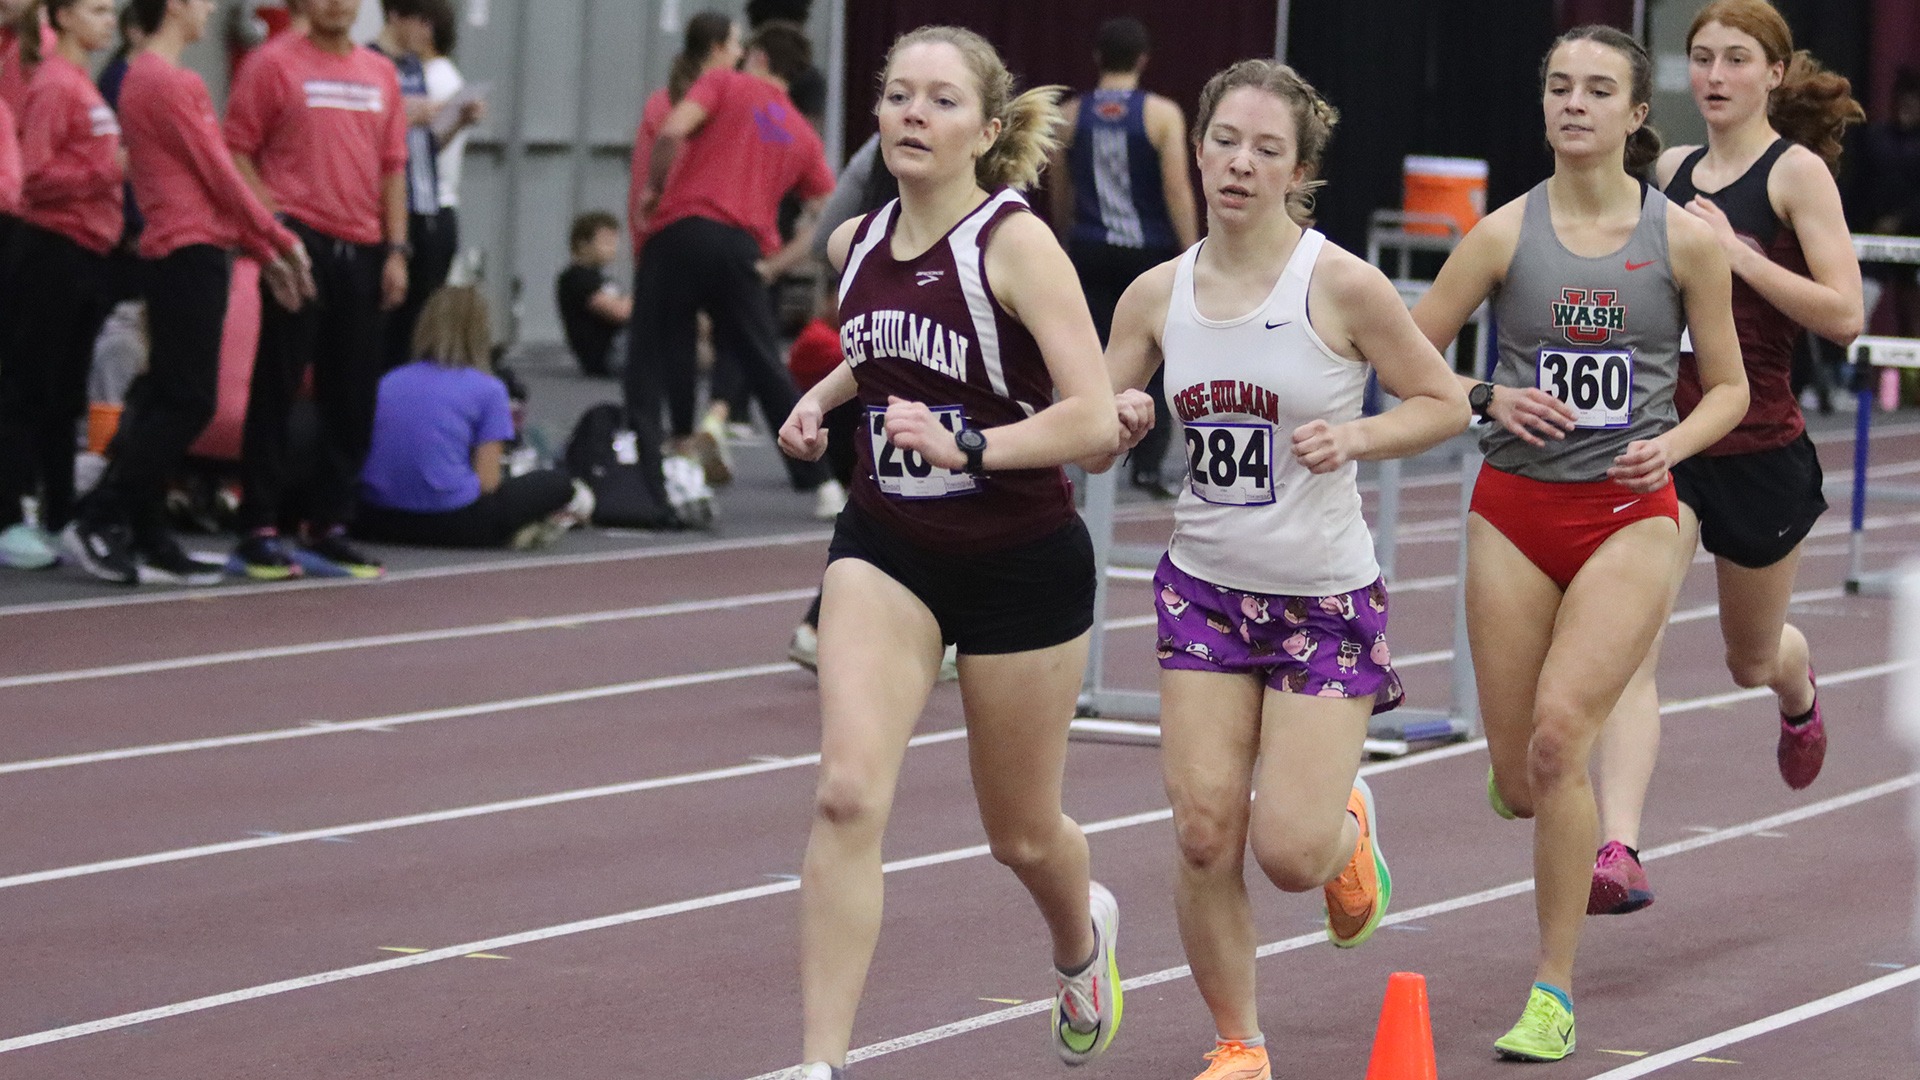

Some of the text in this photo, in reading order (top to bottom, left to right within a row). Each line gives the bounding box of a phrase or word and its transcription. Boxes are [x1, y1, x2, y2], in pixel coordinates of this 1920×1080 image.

[1552, 303, 1626, 332] WASH
[1561, 287, 1618, 345] U
[1173, 380, 1279, 425] ROSE-HULMAN
[1543, 353, 1628, 411] 360
[1184, 428, 1268, 489] 284
